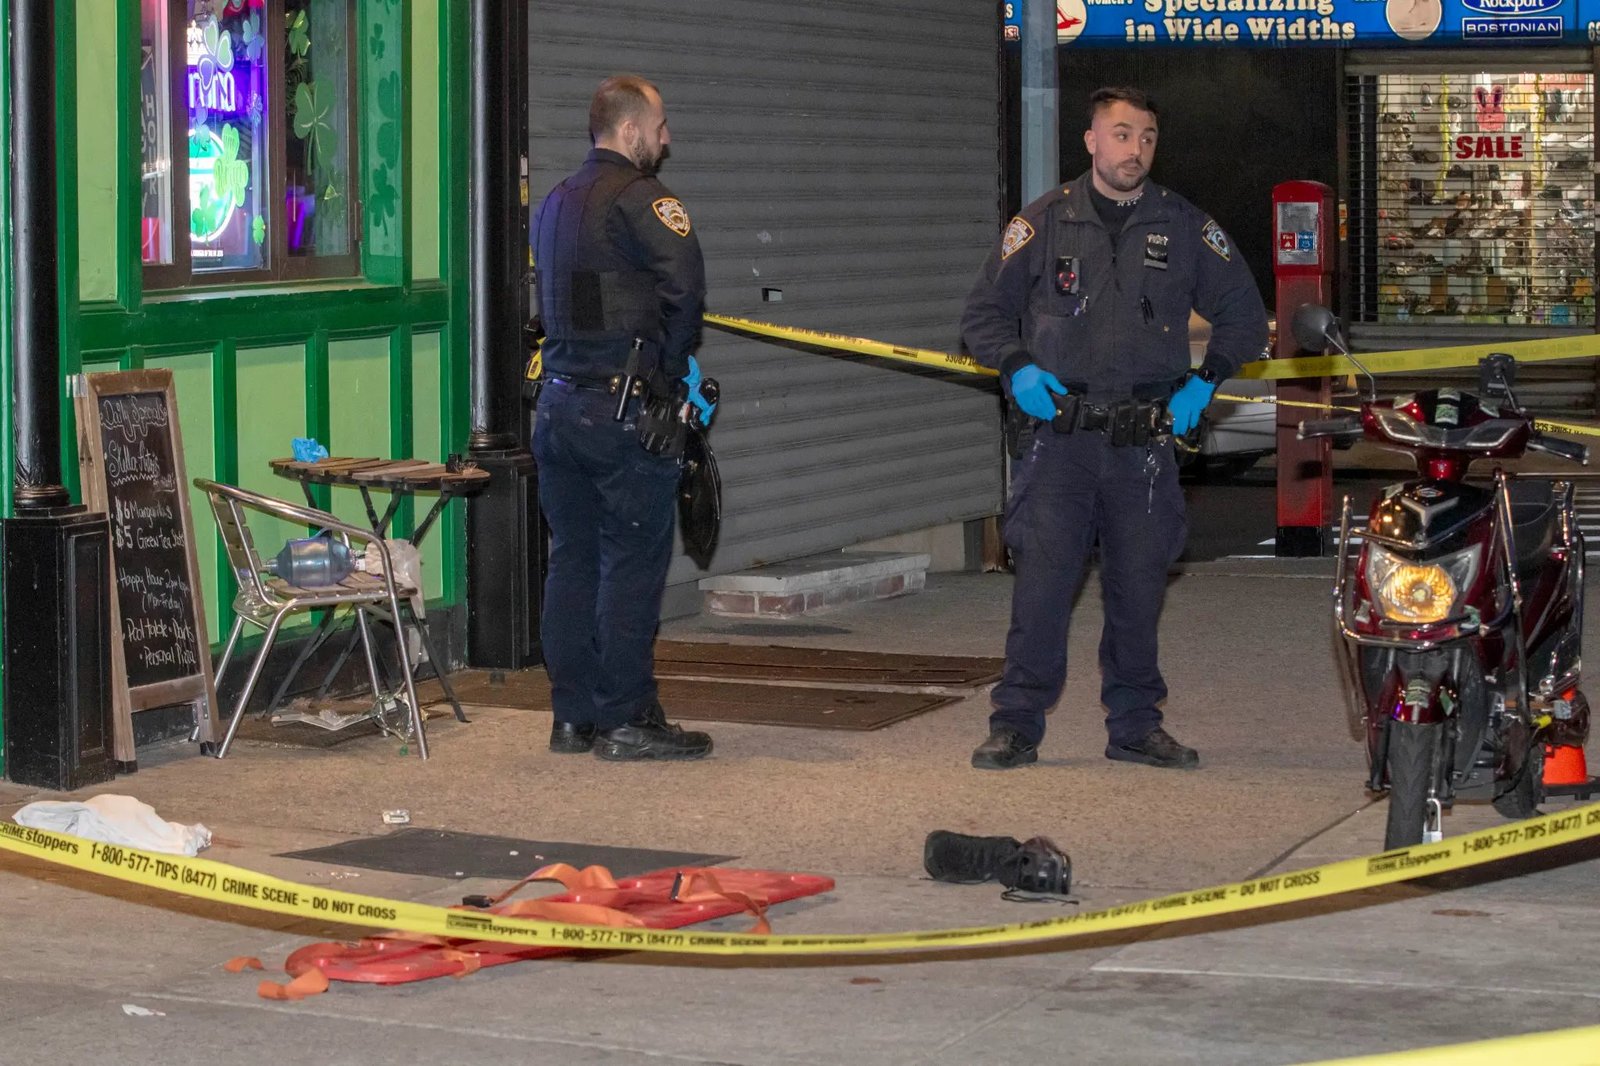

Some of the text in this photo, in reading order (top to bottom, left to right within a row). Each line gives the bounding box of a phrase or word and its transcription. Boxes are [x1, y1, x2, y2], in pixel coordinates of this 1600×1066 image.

[1125, 17, 1355, 42] in Wide Widths
[1466, 23, 1559, 33] BOSTONIAN
[1455, 135, 1523, 159] SALE
[91, 842, 178, 881] 1-800-577-TIPS
[181, 866, 217, 891] (8477)
[222, 878, 258, 898] CRIME
[262, 886, 299, 906] SCENE
[312, 896, 329, 910] DO
[332, 900, 354, 914] NOT
[358, 904, 397, 920] CROSS
[1191, 889, 1227, 904] SCENE
[1240, 883, 1256, 897] DO
[1259, 878, 1281, 893] NOT
[1283, 871, 1321, 889] CROSS
